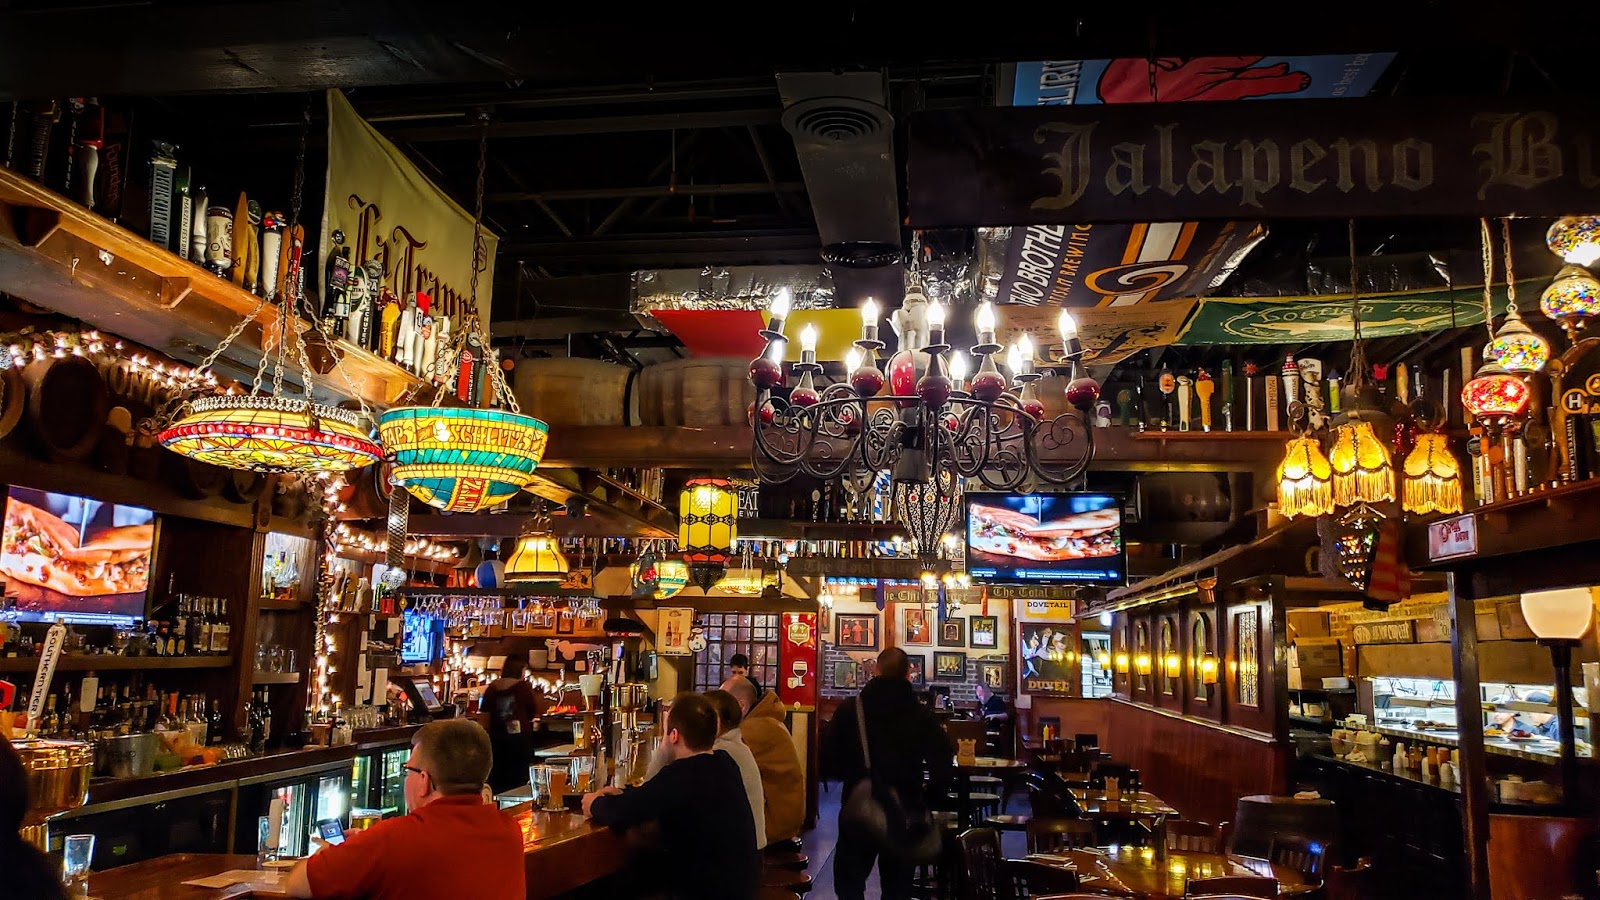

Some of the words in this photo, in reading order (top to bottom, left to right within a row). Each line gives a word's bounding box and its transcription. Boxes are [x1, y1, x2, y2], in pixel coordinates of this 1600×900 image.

[1030, 120, 1434, 210] Jalapeno
[1009, 281, 1045, 307] TWO
[927, 590, 969, 604] Brger
[993, 586, 1015, 597] The
[1018, 586, 1049, 597] Total
[39, 629, 59, 688] SOUTHERN
[1027, 680, 1070, 692] DUVEL
